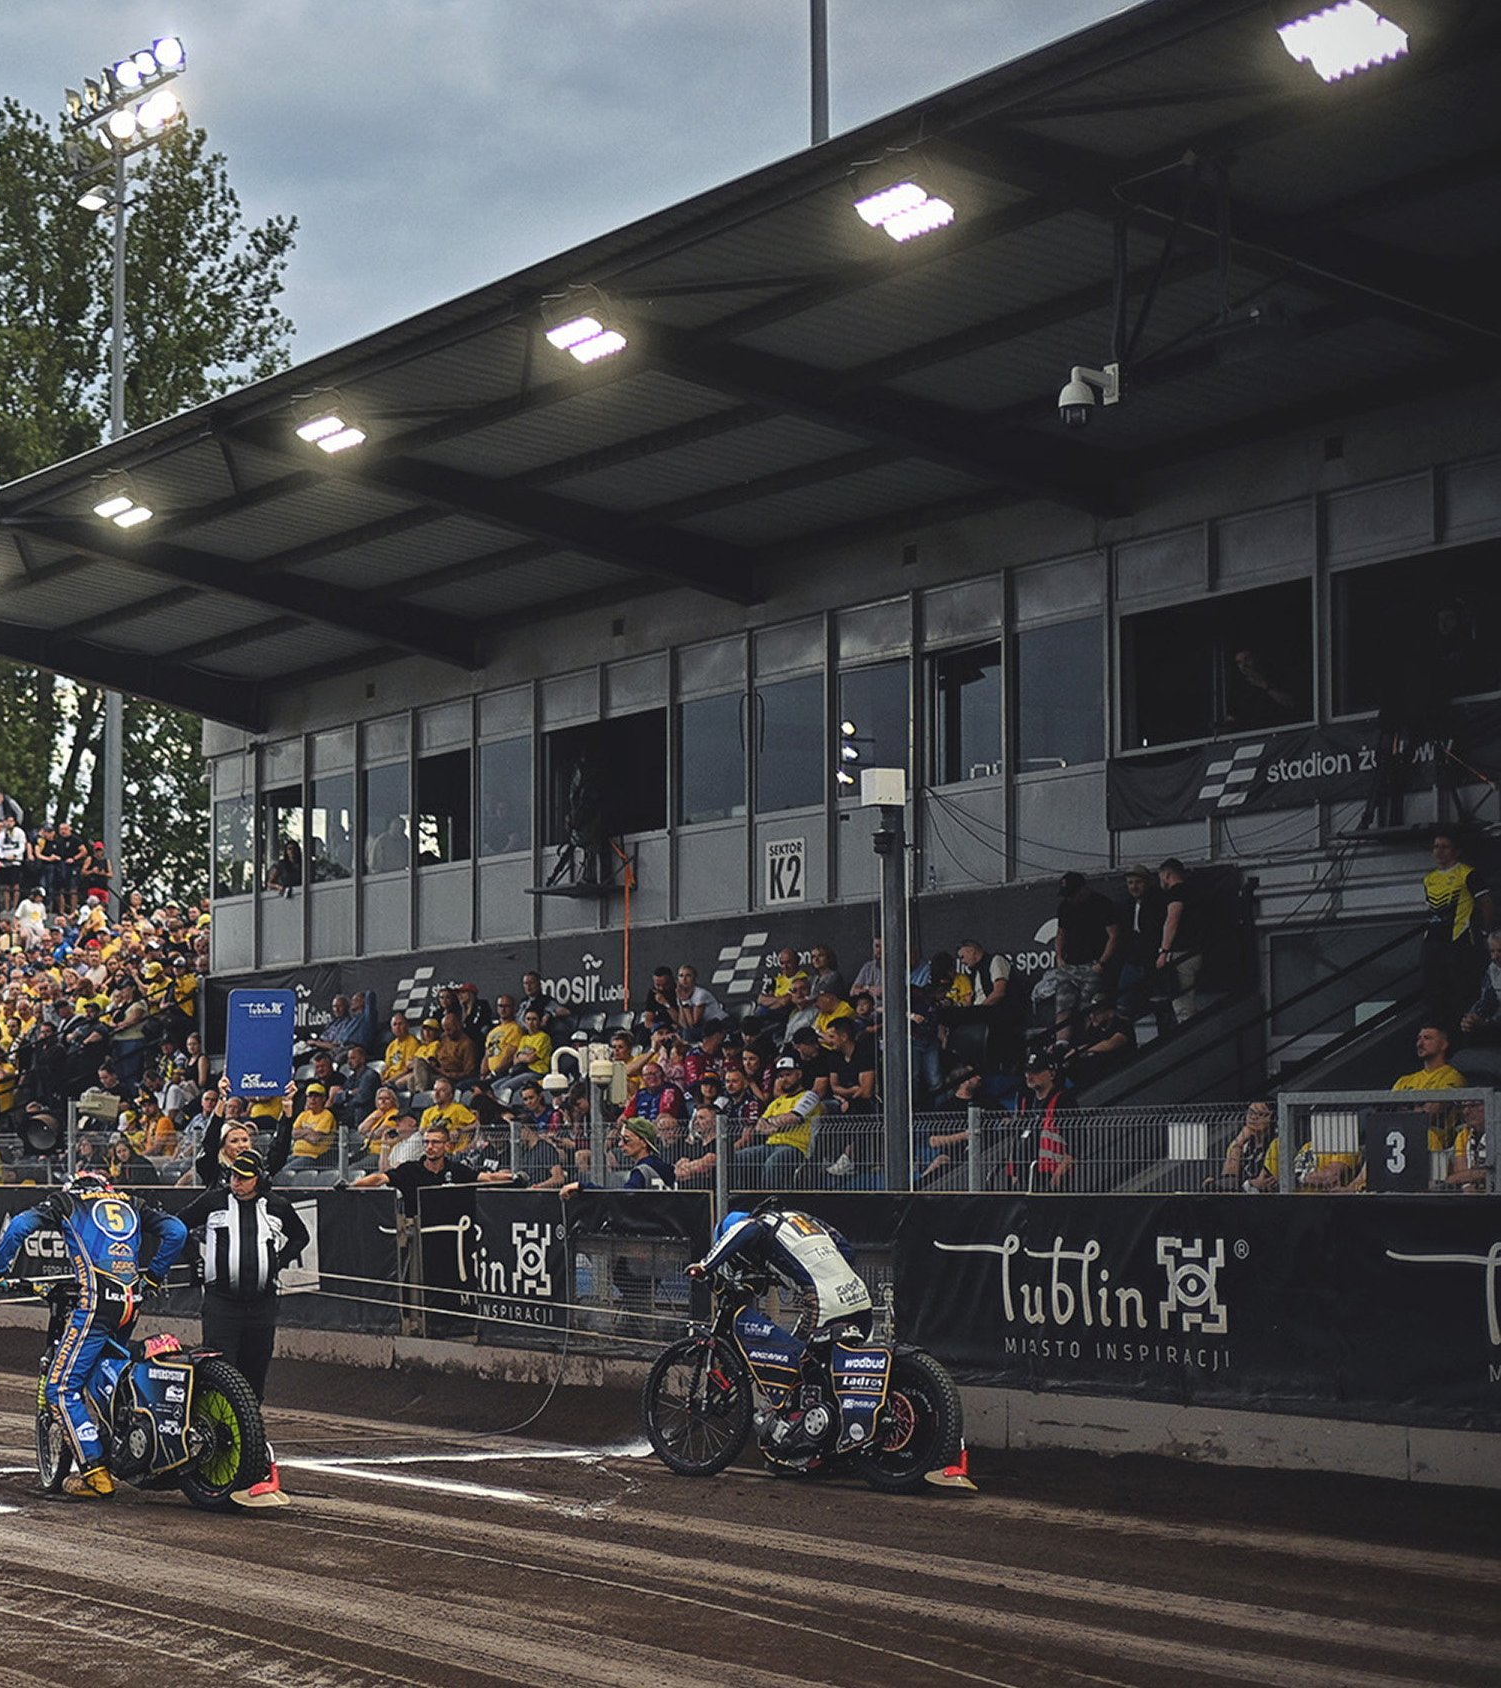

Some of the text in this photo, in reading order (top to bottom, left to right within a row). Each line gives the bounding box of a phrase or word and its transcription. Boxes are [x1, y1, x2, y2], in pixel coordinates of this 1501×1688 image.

[1267, 751, 1352, 783] stadion
[769, 841, 803, 857] SEKTOR
[770, 855, 801, 900] K2
[1386, 1130, 1406, 1174] 3
[104, 1204, 124, 1231] 5
[1004, 1337, 1231, 1372] MIASTO INSPIRACJI
[842, 1376, 883, 1388] Ladros
